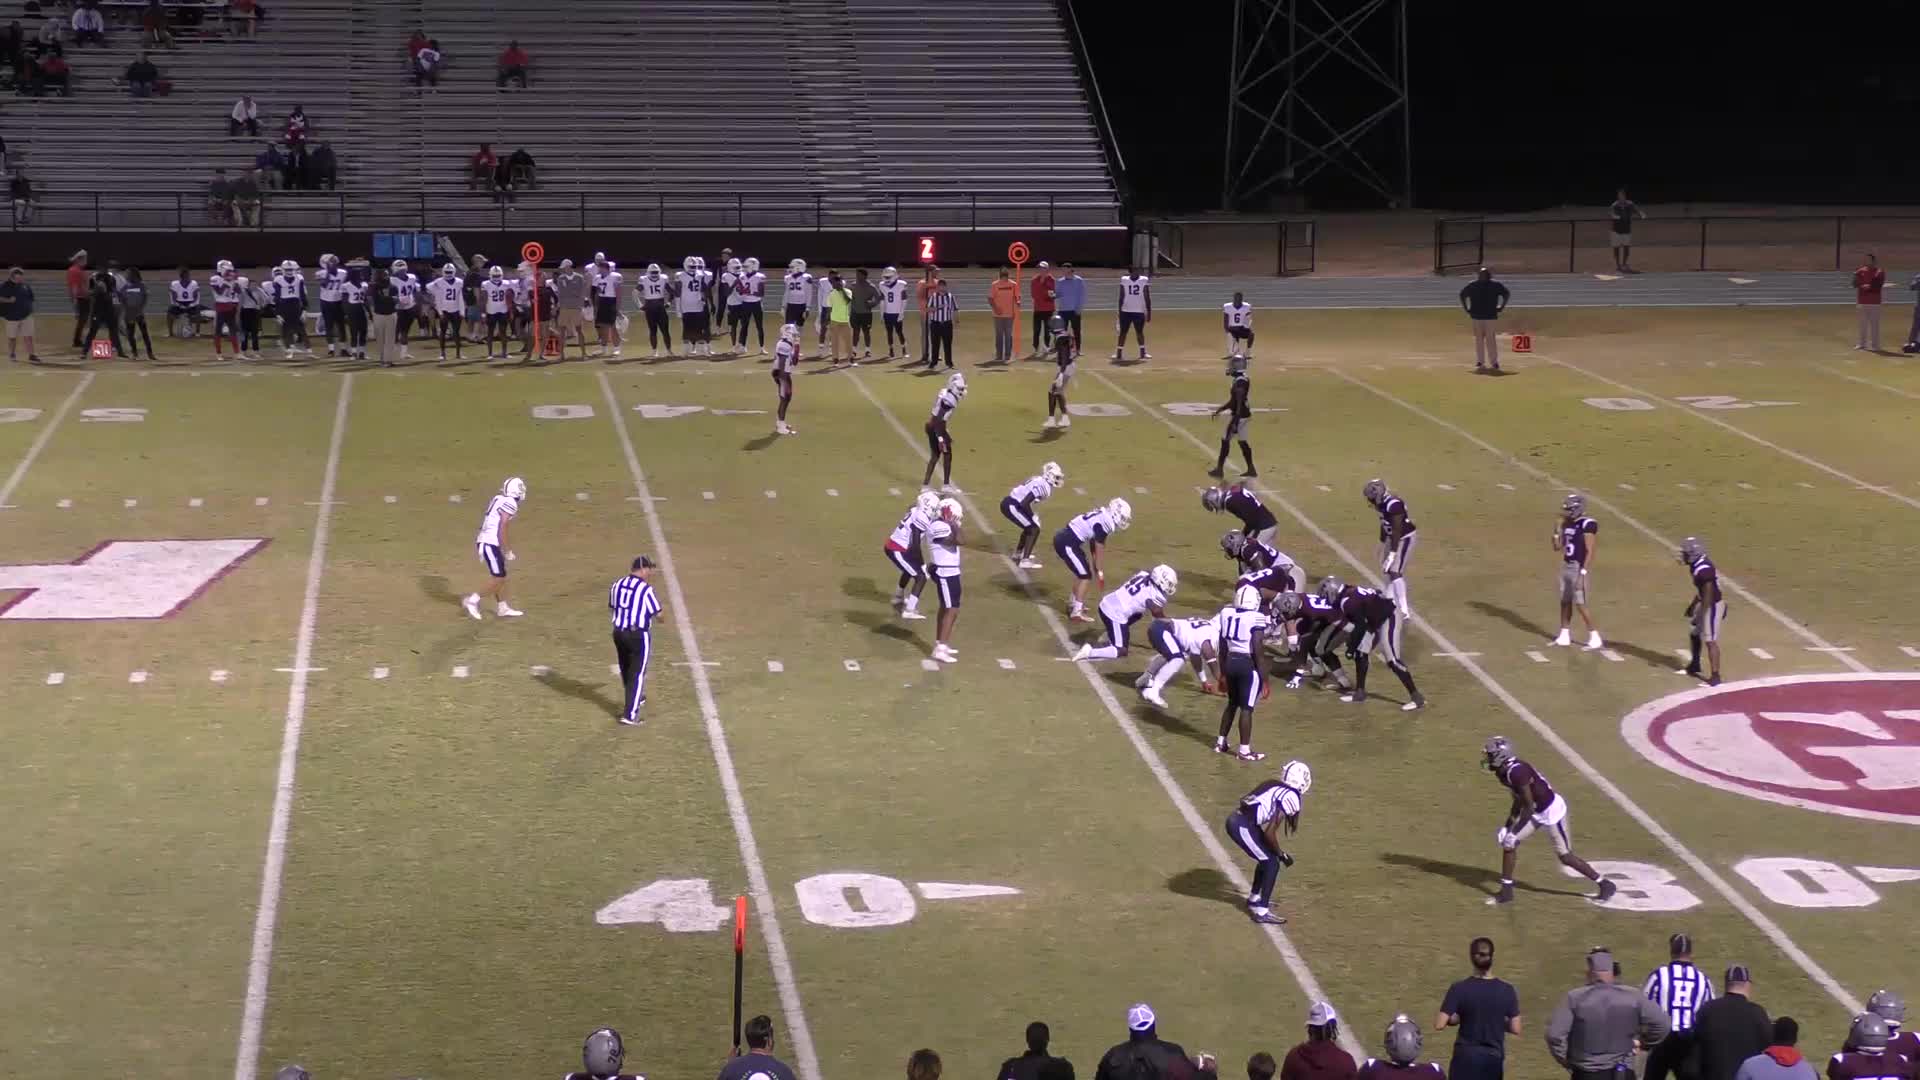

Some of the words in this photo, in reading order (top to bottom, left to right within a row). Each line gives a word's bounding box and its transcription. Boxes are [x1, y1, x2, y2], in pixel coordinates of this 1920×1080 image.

[921, 239, 933, 259] 2
[446, 289, 457, 301] 21
[887, 292, 894, 303] 8
[1129, 285, 1140, 295] 12
[1234, 313, 1241, 324] 6
[1514, 335, 1530, 350] 20
[620, 587, 633, 608] U
[1225, 615, 1242, 641] 11
[1671, 979, 1695, 1007] H
